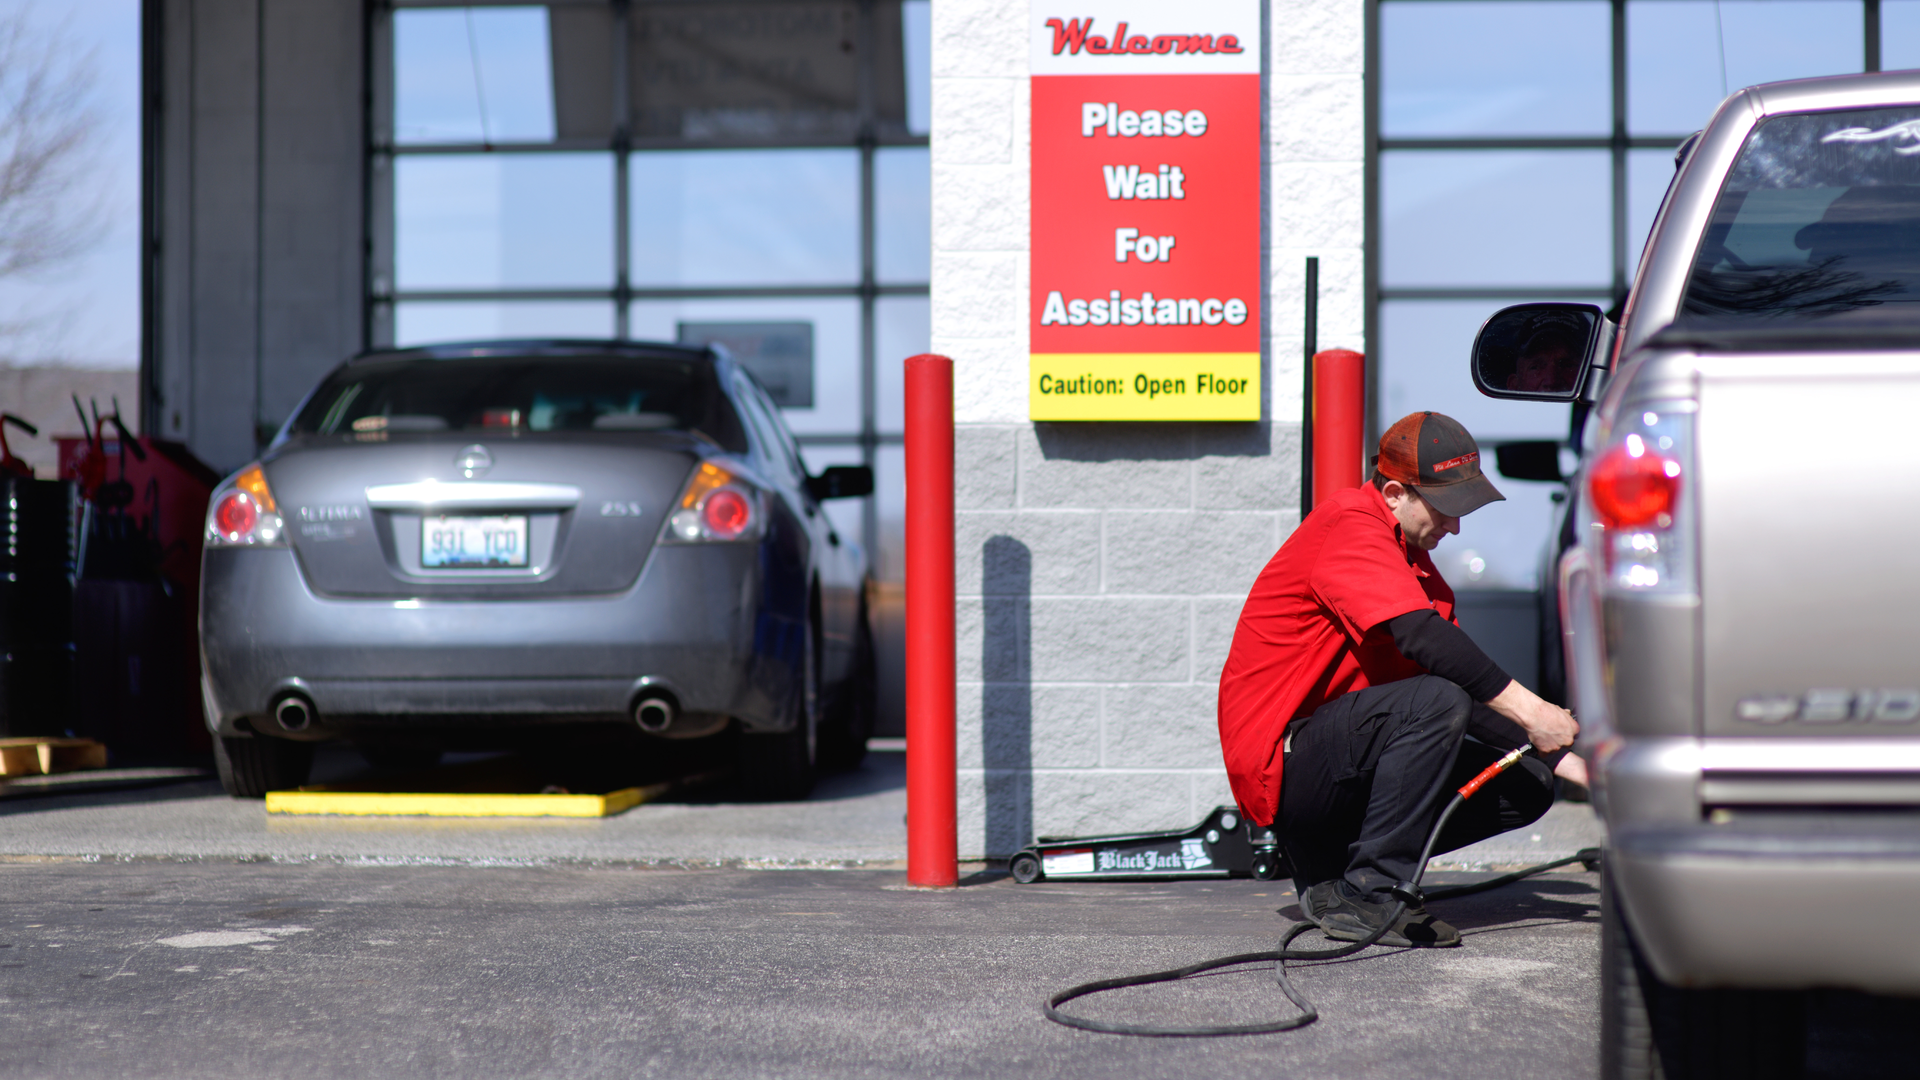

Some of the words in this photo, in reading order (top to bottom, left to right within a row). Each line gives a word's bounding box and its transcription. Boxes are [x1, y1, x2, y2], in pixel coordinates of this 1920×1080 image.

[1045, 18, 1244, 55] Welcome
[1082, 102, 1208, 137] Please
[1103, 164, 1185, 200] Wait
[1115, 227, 1175, 262] For
[1040, 290, 1248, 326] Assistance
[1040, 374, 1124, 395] Caution:
[1134, 374, 1186, 398] Open
[1197, 374, 1248, 395] Floor
[432, 529, 466, 554] 931
[1098, 850, 1181, 871] BlackJack
